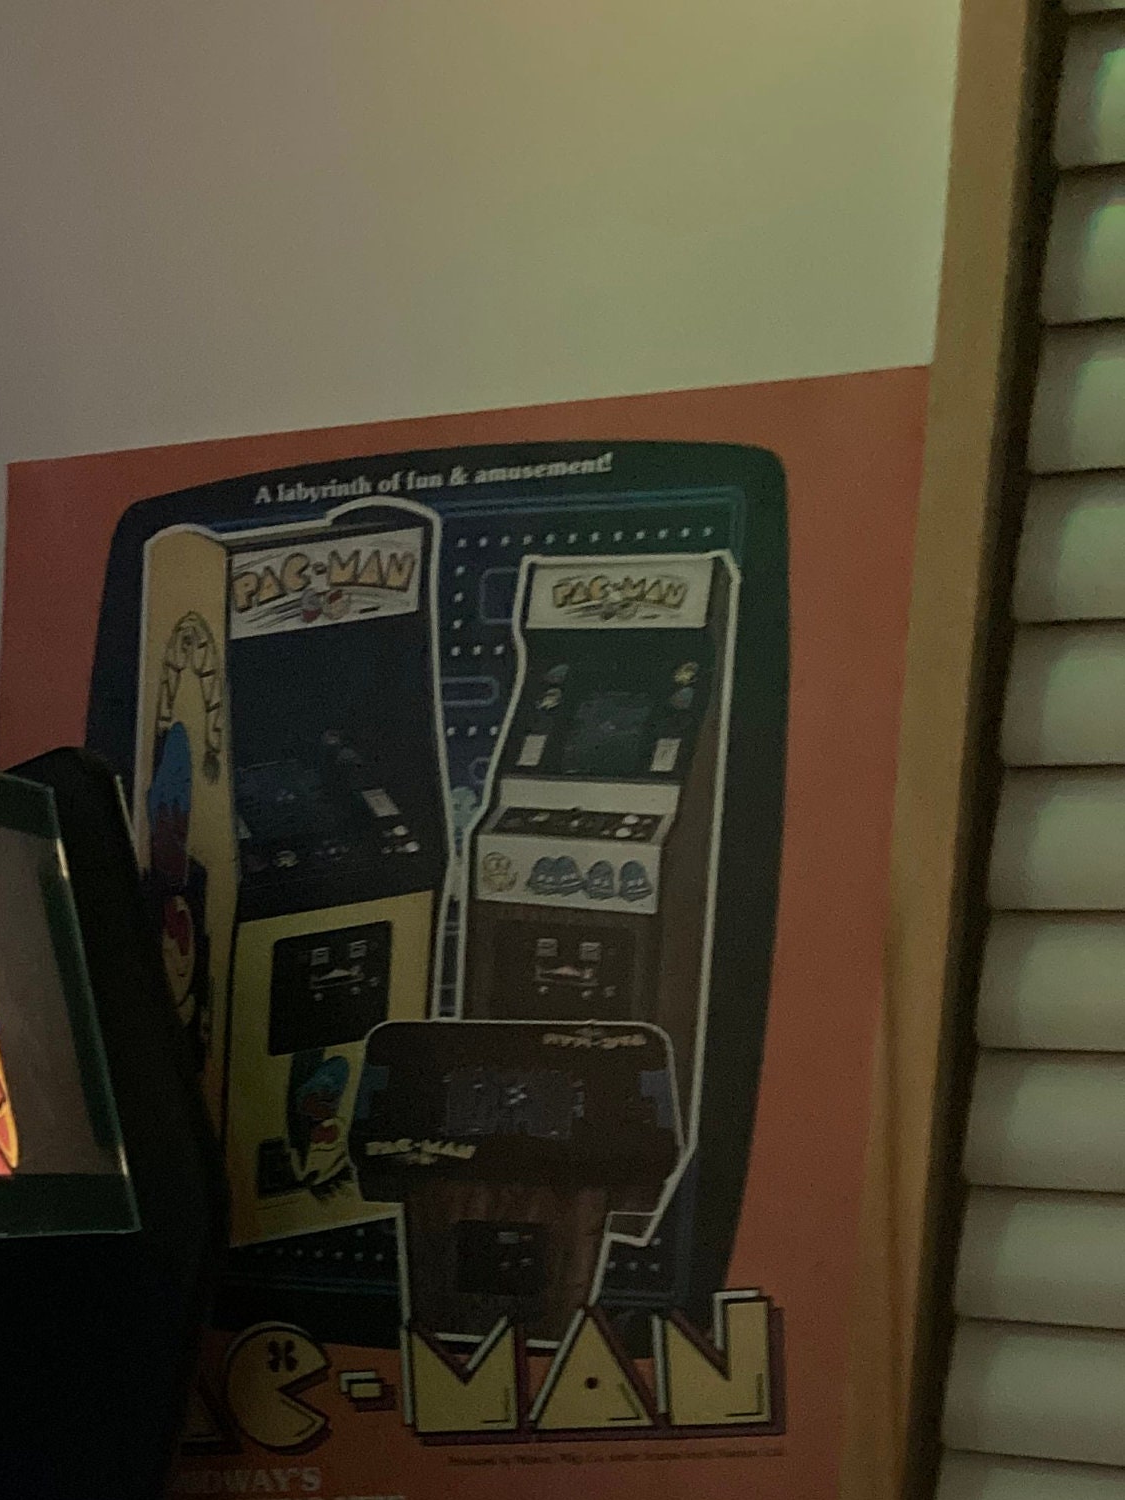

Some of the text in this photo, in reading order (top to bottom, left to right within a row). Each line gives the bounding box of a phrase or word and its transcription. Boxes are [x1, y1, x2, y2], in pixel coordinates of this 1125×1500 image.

[255, 451, 614, 505] A labyrinth of fun & amusement!
[231, 549, 416, 613] PAC-MAN
